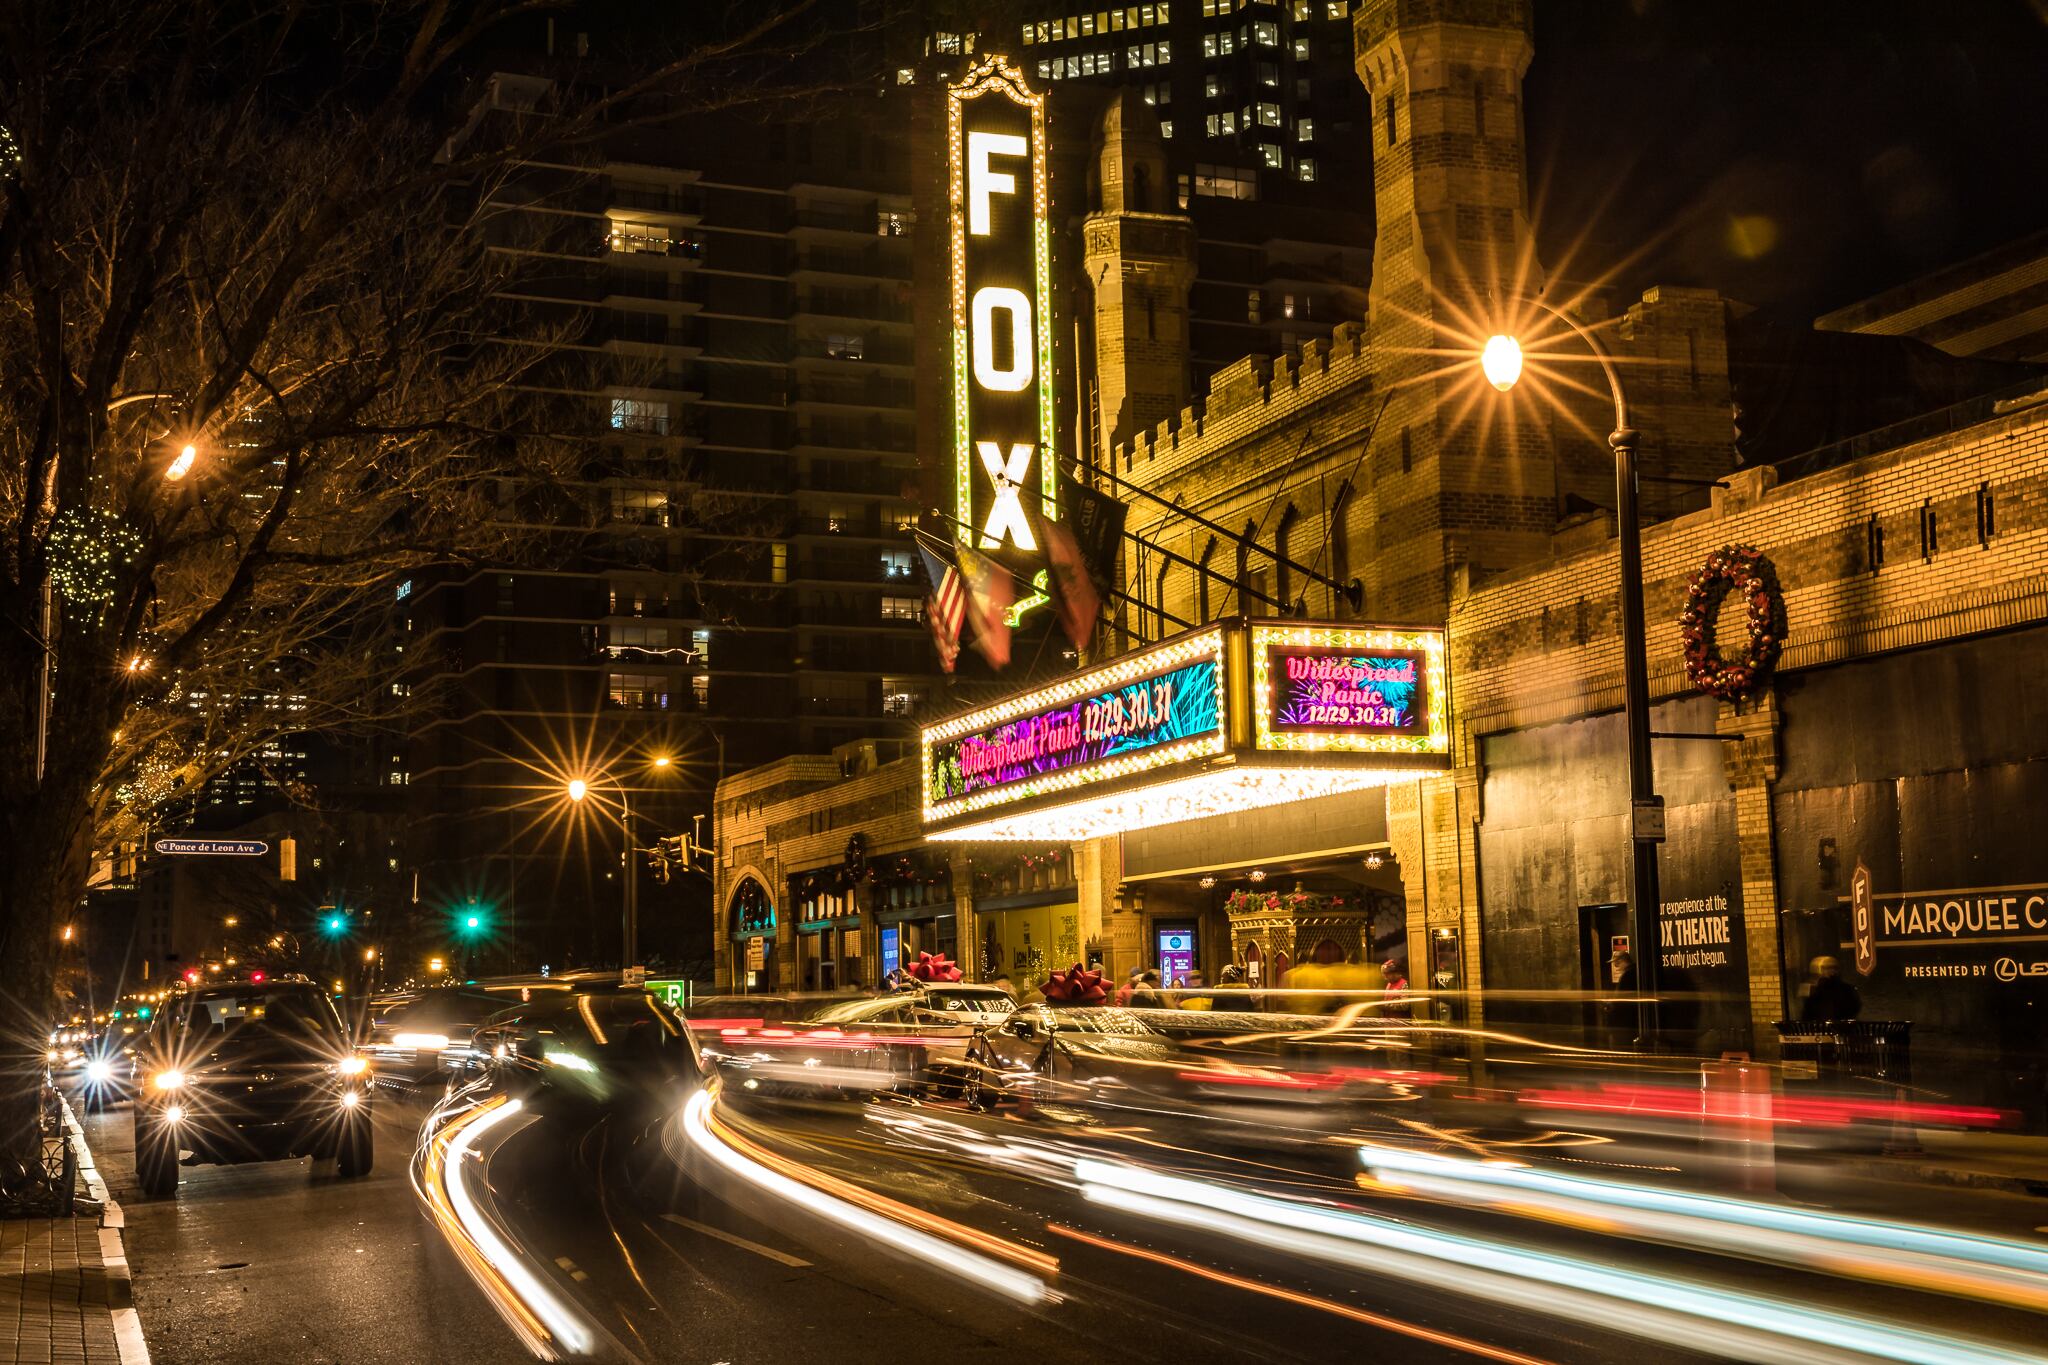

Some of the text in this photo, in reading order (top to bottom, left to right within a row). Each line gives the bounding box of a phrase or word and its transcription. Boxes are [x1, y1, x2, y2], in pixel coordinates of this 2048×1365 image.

[967, 131, 1039, 552] FOX
[1285, 656, 1416, 689] Widespread
[1321, 681, 1384, 705] Panic
[1309, 705, 1396, 725] 12/29,30,31
[959, 681, 1172, 780] Widespread Panic 12/29,30,31
[169, 842, 196, 851] Ponce
[198, 843, 210, 852] de
[212, 843, 234, 852] Leon
[237, 844, 255, 852] Ave
[1666, 898, 1704, 916] experience
[1705, 896, 1713, 912] at
[1714, 894, 1727, 911] the
[1884, 897, 2020, 937] MARQUEE
[1675, 916, 1730, 946] THEATRE
[1855, 879, 1870, 960] FOX
[1670, 950, 1685, 968] only
[1686, 950, 1700, 968] just
[1701, 949, 1727, 967] begun.
[1905, 965, 1968, 977] PRESENTED
[1973, 965, 1987, 976] BY
